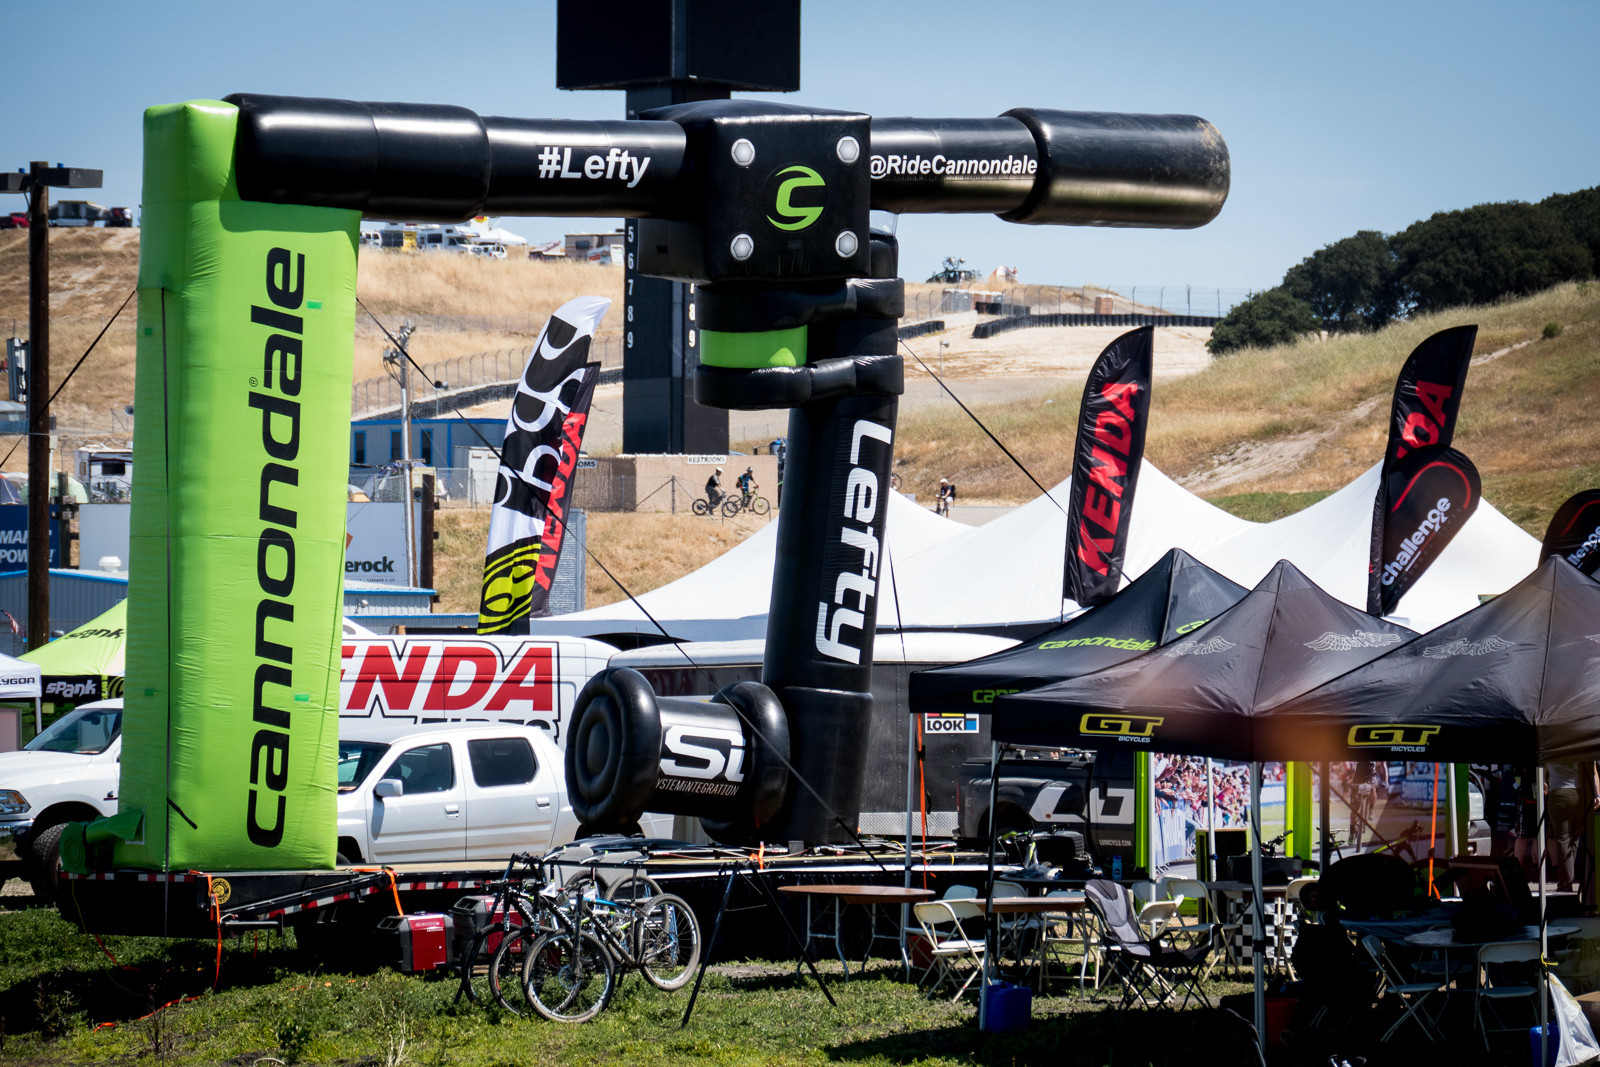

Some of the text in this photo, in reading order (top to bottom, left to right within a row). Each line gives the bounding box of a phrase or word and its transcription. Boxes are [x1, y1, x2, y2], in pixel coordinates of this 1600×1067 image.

[538, 146, 651, 188] #Lefty
[870, 154, 1038, 180] @RideCannondale
[628, 226, 634, 243] 5
[628, 253, 634, 269] 6
[627, 279, 634, 296] 7
[627, 305, 634, 322] 8
[627, 331, 634, 348] 9
[688, 329, 696, 347] 9
[688, 456, 725, 464] RESTROOMS
[1077, 382, 1138, 577] KENDA
[247, 246, 305, 848] cannondale
[815, 419, 892, 665] Lefty
[1381, 497, 1451, 586] challenge
[1038, 636, 1157, 651] cannondale
[927, 719, 964, 732] LOOK
[1079, 713, 1165, 737] GT
[1118, 735, 1151, 743] BICYCLES
[1347, 724, 1442, 746] GT
[1390, 745, 1426, 753] BICYCLES
